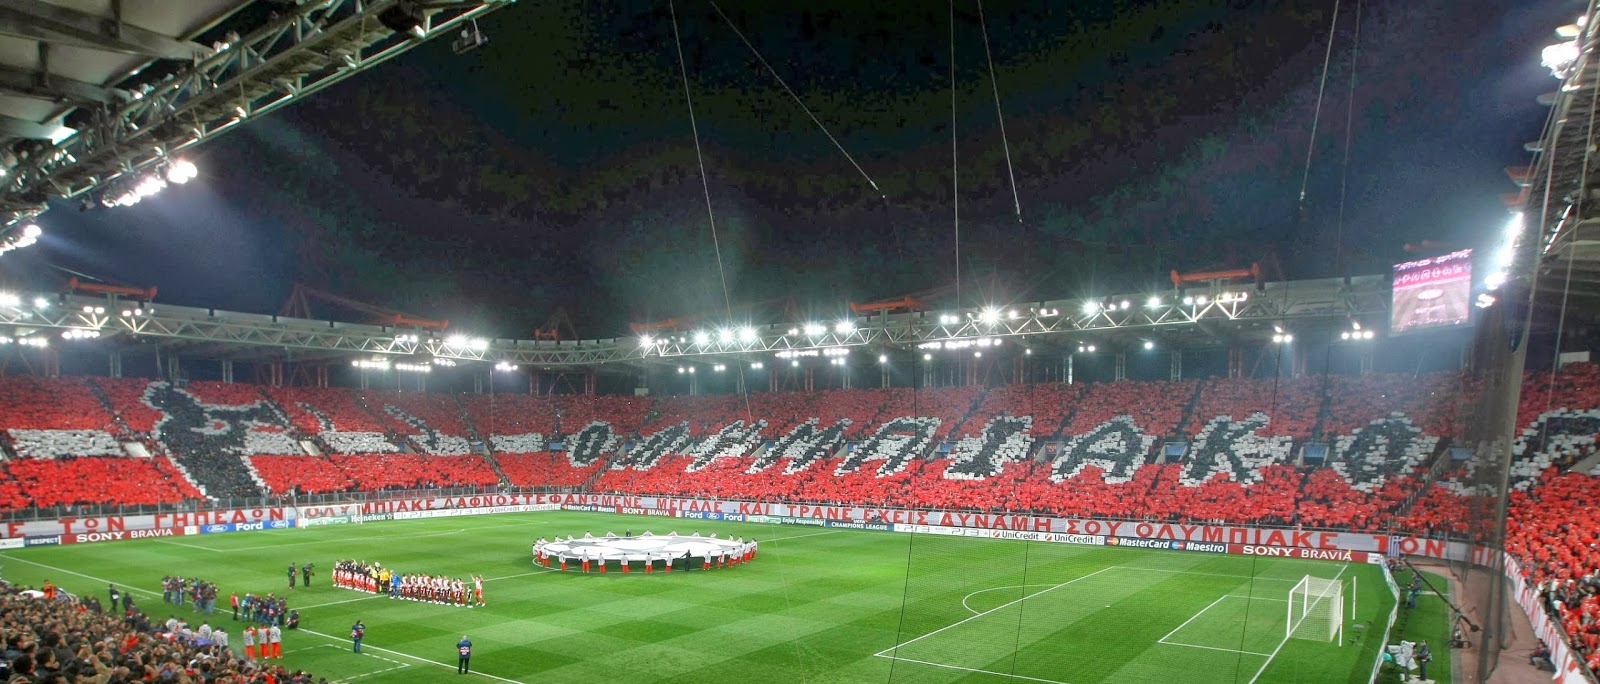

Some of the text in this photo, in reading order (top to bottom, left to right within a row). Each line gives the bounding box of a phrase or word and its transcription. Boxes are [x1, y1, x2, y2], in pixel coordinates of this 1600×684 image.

[622, 507, 670, 517] SONY BRAVIA
[685, 511, 703, 519] Ford
[723, 513, 743, 521] Ford
[351, 513, 386, 523] Heineken
[235, 521, 263, 532] Ford
[656, 497, 723, 513] ΜΕΓΑΛΕ
[739, 501, 770, 515] ΚΑΙ
[787, 504, 852, 521] ΤΡΑΝΕ
[863, 508, 929, 525] ΕΧΕΙΣ
[939, 512, 1051, 533] ΔΥΝΑΜΗ
[1066, 519, 1124, 538] ΣΟΥ
[1135, 523, 1338, 550] ΟΛΥΜΠΙΑΚΕ
[831, 521, 864, 529] CHAMPIONS
[76, 528, 174, 543] SONY BRAVIA
[1001, 531, 1039, 540] UniCredit
[1054, 534, 1093, 544] UniCredit
[29, 537, 59, 545] RESPECT
[1119, 538, 1170, 549] MasterCard
[1185, 542, 1225, 553] Maestro
[1243, 545, 1352, 561] SONY BRAVIA
